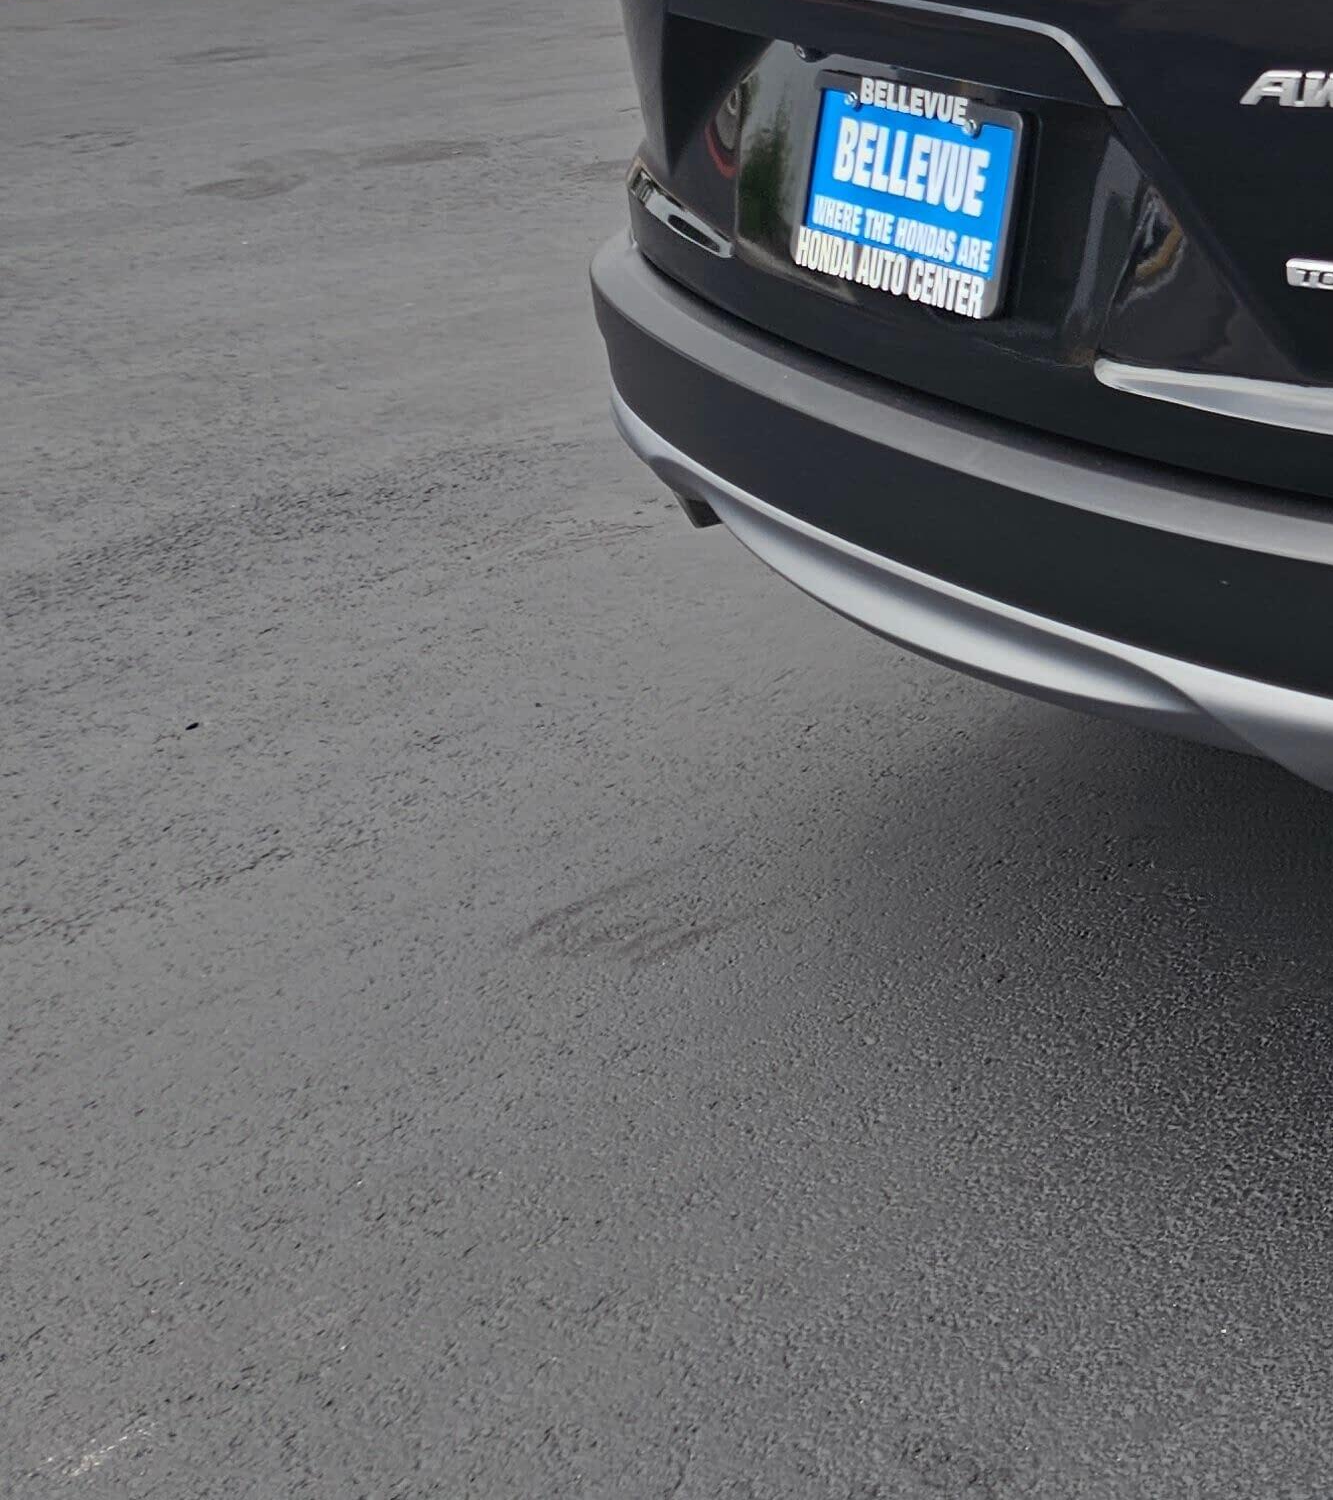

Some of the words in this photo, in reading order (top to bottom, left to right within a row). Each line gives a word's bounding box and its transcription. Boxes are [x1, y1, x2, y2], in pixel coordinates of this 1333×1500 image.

[860, 77, 969, 126] BELLEVUE
[832, 116, 991, 217] BELLEVUE
[795, 226, 856, 281] HONDA
[855, 244, 908, 296] AUTO
[907, 259, 985, 320] CENTER
[811, 194, 864, 237] WHERE
[863, 208, 896, 245] THE
[894, 217, 957, 263] HONDAS
[956, 235, 993, 273] ARE
